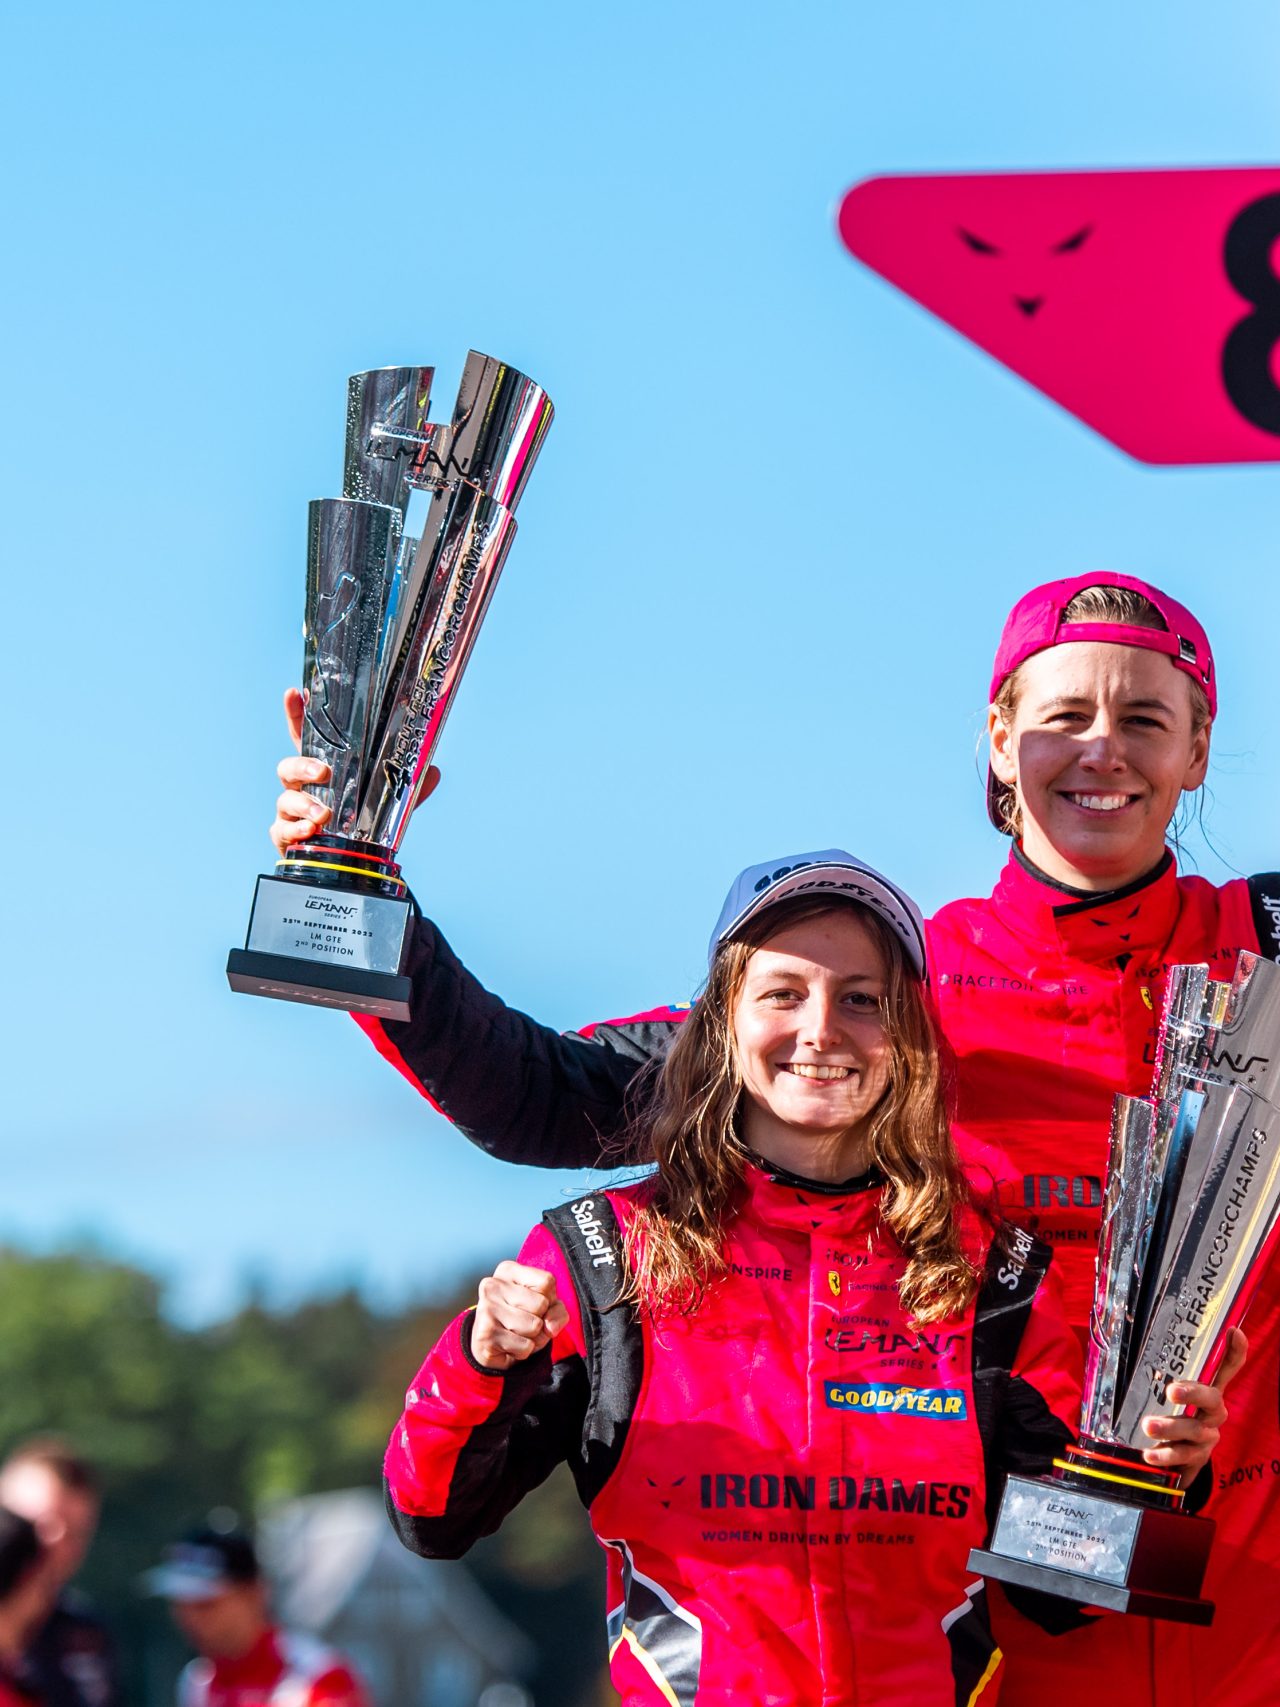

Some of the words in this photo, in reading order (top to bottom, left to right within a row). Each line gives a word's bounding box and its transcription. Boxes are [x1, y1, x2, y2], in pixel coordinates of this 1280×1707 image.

[304, 921, 348, 933] SEPTEMBER
[352, 929, 373, 937] 2022
[310, 932, 322, 941] LM
[325, 935, 342, 944] GTE
[311, 943, 354, 956] POSITION
[1181, 1064, 1223, 1083] SERIES
[1023, 1175, 1102, 1208] IRO
[571, 1200, 617, 1268] Sabelt
[1042, 1229, 1088, 1241] OMEN
[1169, 1334, 1195, 1375] SPA
[1186, 1127, 1267, 1328] FRANCORCHAMPS
[880, 1359, 925, 1370] SERIES
[830, 1386, 962, 1413] GOODYEAR
[701, 1474, 816, 1511] IRON
[828, 1476, 971, 1519] DAMES
[702, 1531, 763, 1542] WOMEN
[769, 1532, 829, 1545] DRIVEN
[835, 1534, 851, 1545] BY
[857, 1532, 915, 1545] DREAMS
[1044, 1525, 1083, 1538] SEPTEMBER
[1049, 1536, 1059, 1545] LM
[1062, 1538, 1077, 1549] GTE
[1049, 1546, 1087, 1562] POSITION
